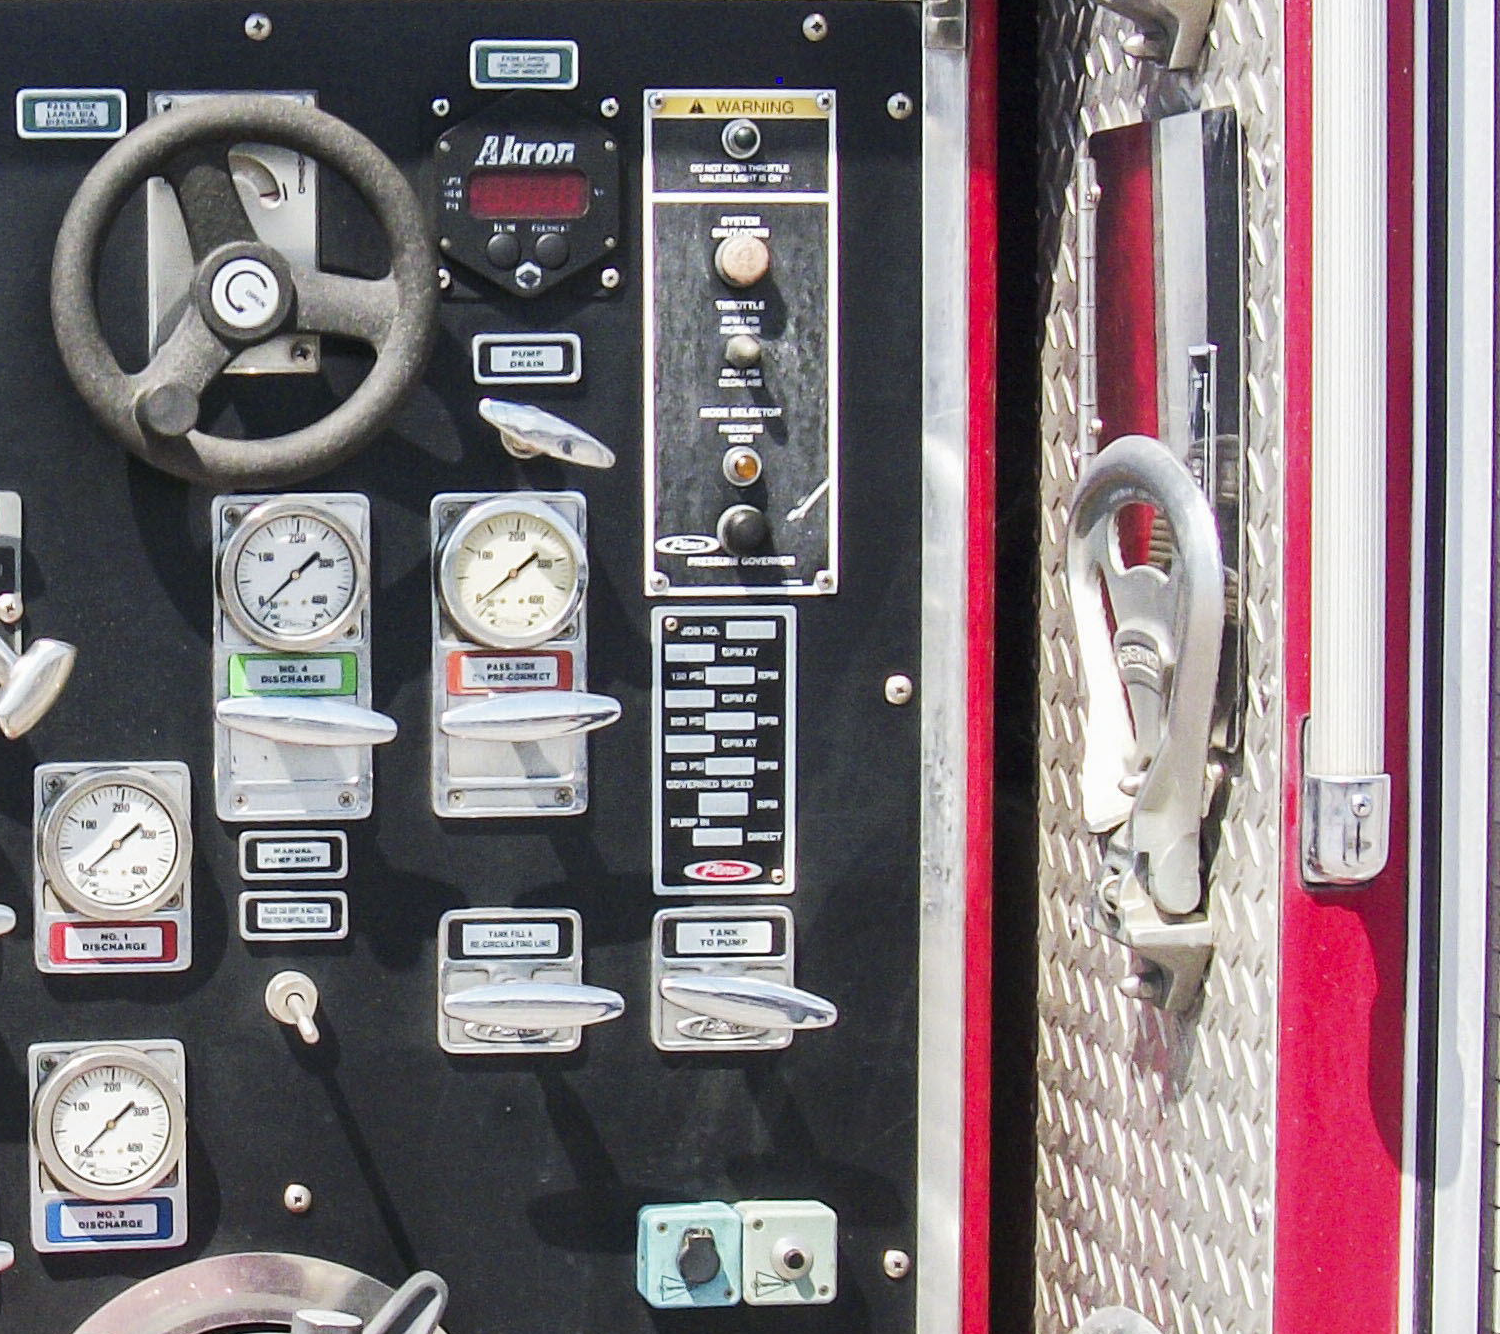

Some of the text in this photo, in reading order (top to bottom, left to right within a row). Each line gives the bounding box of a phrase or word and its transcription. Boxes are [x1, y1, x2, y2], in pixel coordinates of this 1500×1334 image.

[716, 101, 794, 114] WARNING
[474, 135, 575, 166] Akron
[690, 164, 790, 173] DO NOT OPEN THROTTLE
[699, 174, 732, 182] UNLESS
[733, 174, 756, 182] LIGHT
[759, 174, 766, 182] IS
[715, 301, 765, 310] THROTTLE
[511, 350, 543, 358] PUMP
[509, 360, 544, 369] DRAIN
[681, 626, 720, 636] JOB NO.
[745, 647, 758, 657] AT
[278, 665, 308, 674] NO. 4
[261, 674, 326, 684] DISCHARGE
[670, 818, 710, 827] PUMP IN
[101, 933, 120, 941] NO.
[82, 942, 148, 951] DISCHARGE
[535, 939, 551, 948] LINE
[700, 938, 748, 947] TO PUMP
[103, 1082, 121, 1092] 200
[73, 1102, 89, 1111] 100
[132, 1107, 149, 1117] 300
[74, 1145, 80, 1154] 0
[127, 1143, 143, 1153] 400
[96, 1211, 125, 1219] NO. 2
[78, 1220, 143, 1229] DISCHARGE
